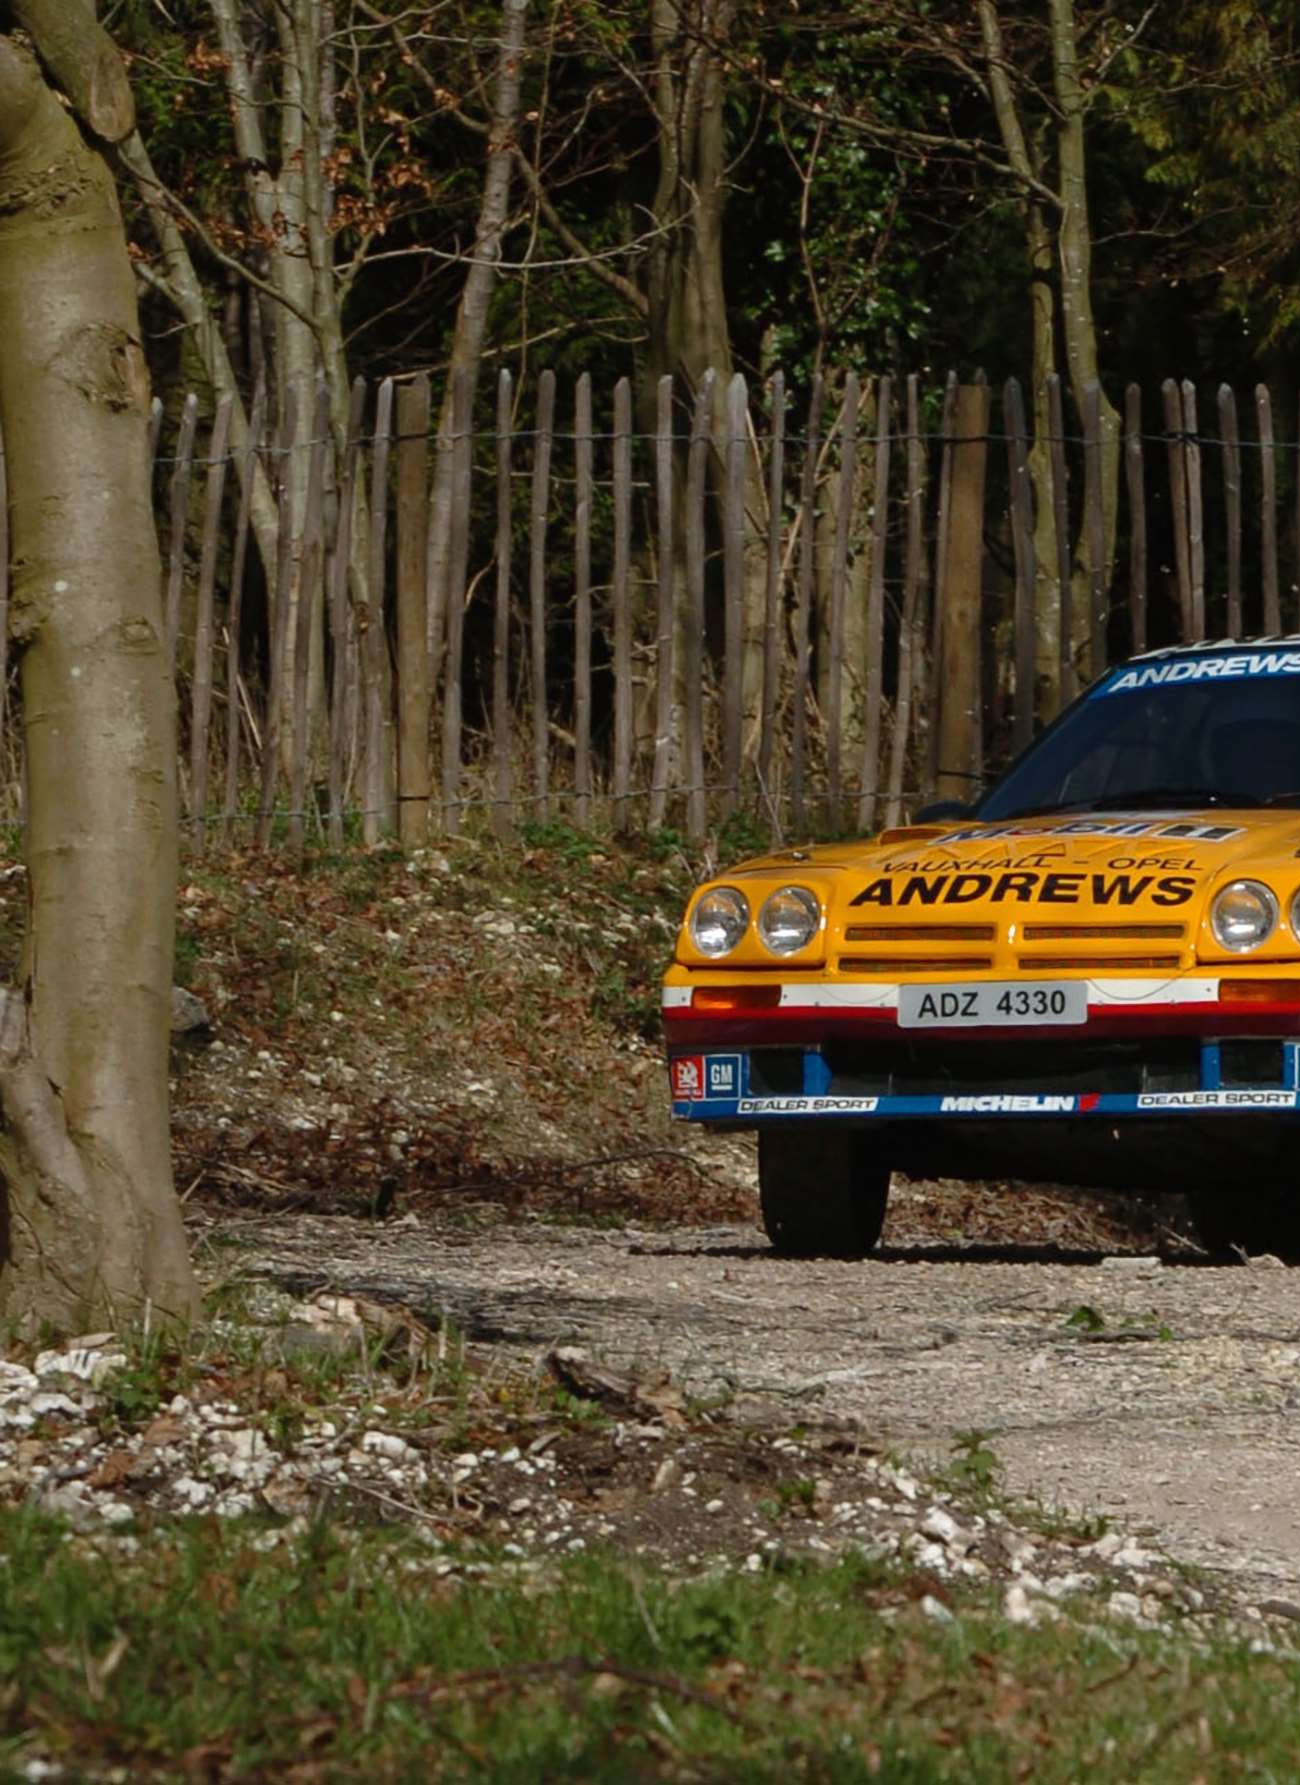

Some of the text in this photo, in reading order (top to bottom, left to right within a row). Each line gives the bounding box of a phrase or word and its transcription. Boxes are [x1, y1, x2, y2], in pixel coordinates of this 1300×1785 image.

[934, 823, 1151, 844] Mobil
[883, 855, 1054, 873] VAUXHALL
[1108, 857, 1204, 871] OPEL
[849, 873, 1198, 906] ANDREWS
[918, 990, 1066, 1018] ADZ 4330
[711, 1064, 733, 1085] GM
[741, 1099, 874, 1112] DEALER SPORT
[941, 1096, 1075, 1112] MICHELIN
[1140, 1093, 1293, 1106] DEALER SPORT
